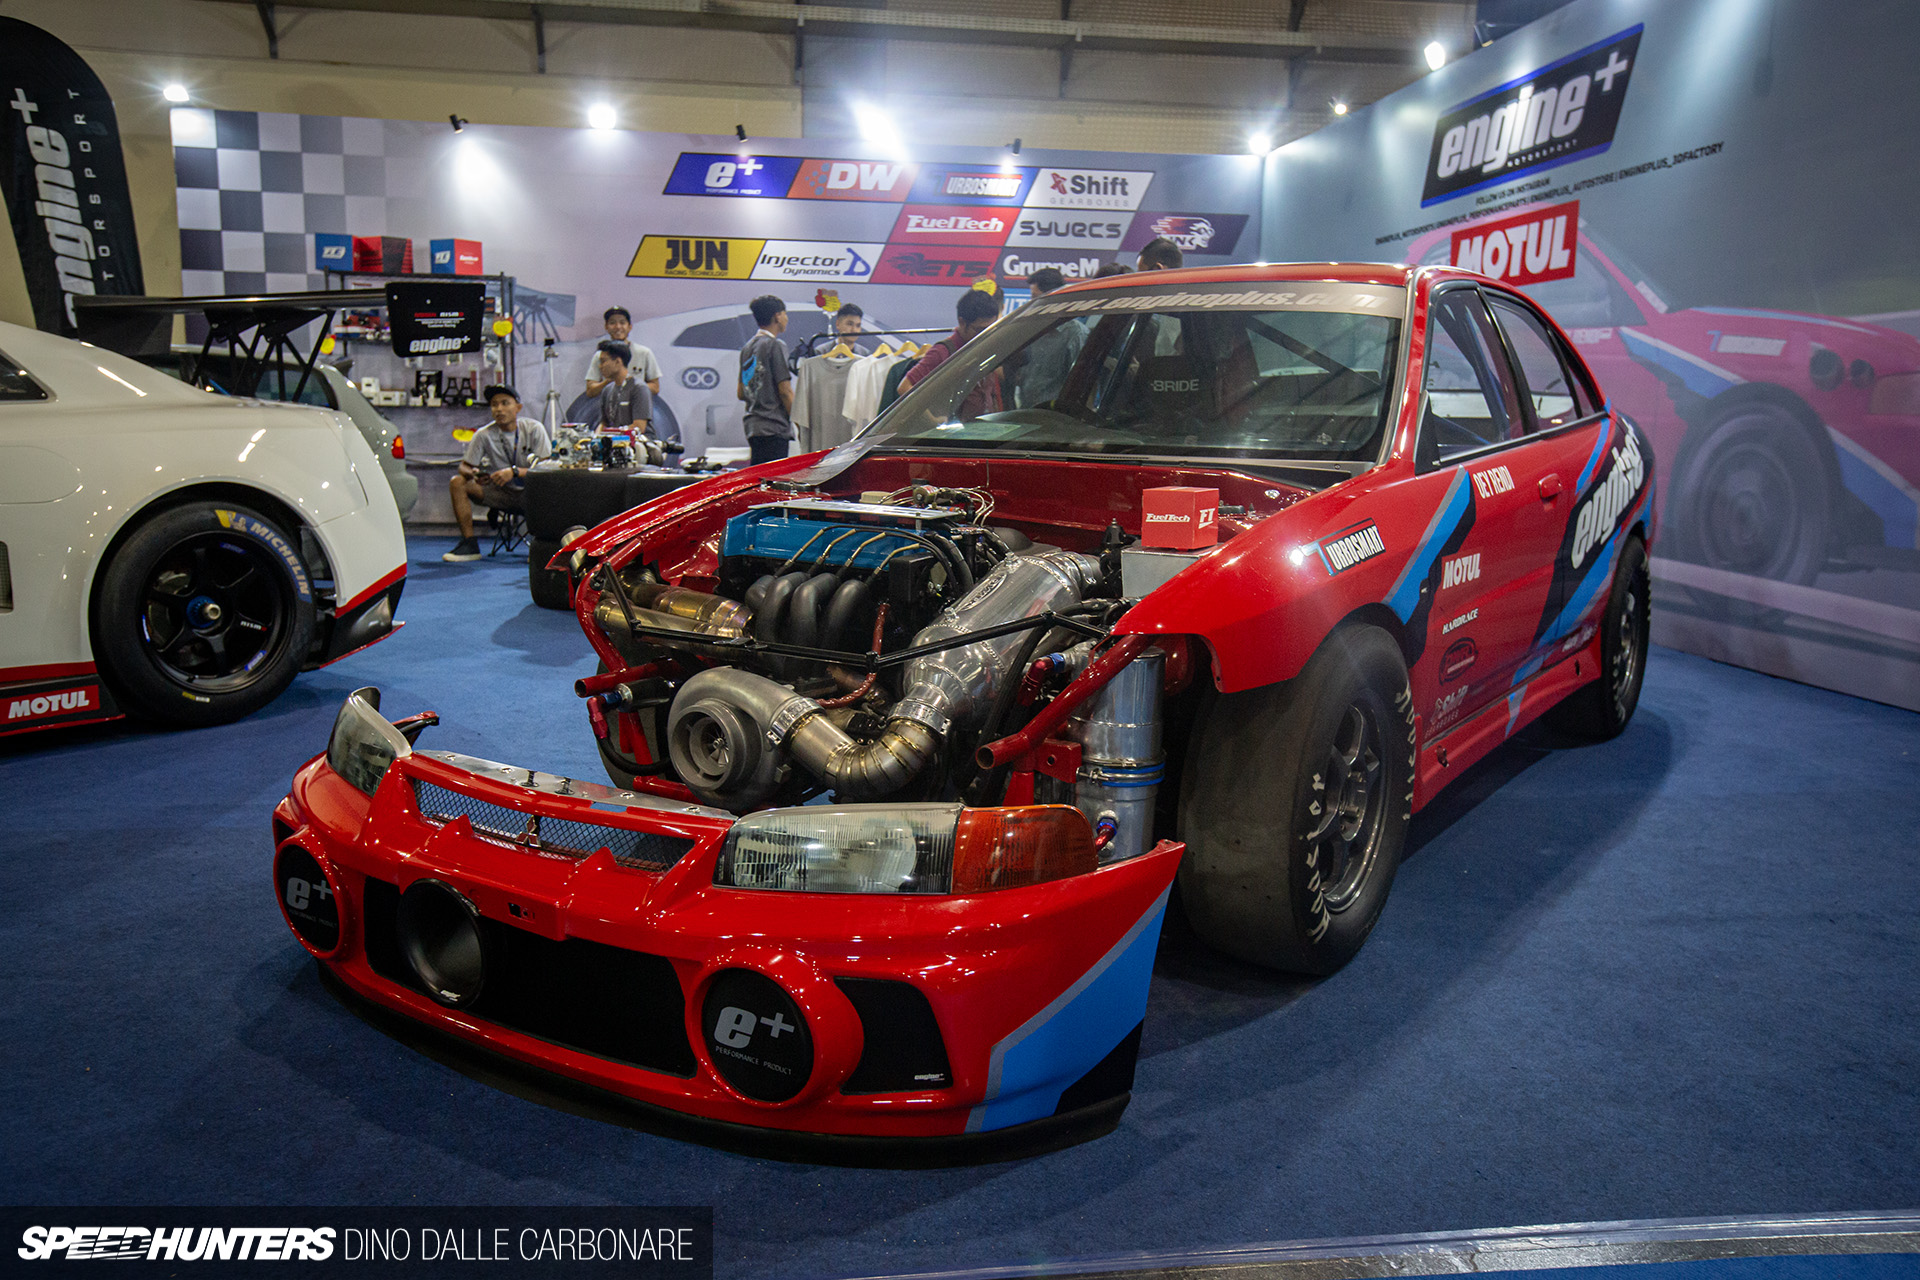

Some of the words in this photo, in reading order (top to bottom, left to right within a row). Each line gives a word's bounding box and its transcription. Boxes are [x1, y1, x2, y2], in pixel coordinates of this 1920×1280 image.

[1437, 51, 1628, 179] engine+
[826, 162, 905, 191] DW
[1050, 197, 1129, 208] GEARBOXES
[906, 214, 1004, 233] FuelTech
[665, 239, 728, 271] JUN
[1456, 215, 1571, 280] MOTUL
[761, 253, 846, 268] Injector
[783, 267, 841, 276] Dynamics
[921, 259, 992, 277] ETS
[409, 335, 470, 354] engine+
[1154, 379, 1199, 393] BRIDE
[1145, 513, 1191, 522] FuelTech
[1198, 508, 1215, 525] FT
[250, 522, 311, 595] MICHELIN
[1443, 553, 1481, 589] MOTUL
[8, 690, 90, 719] MOTUL
[713, 1006, 795, 1049] e+
[715, 1045, 760, 1066] PERFORMANCE
[763, 1060, 792, 1076] PRODUCT
